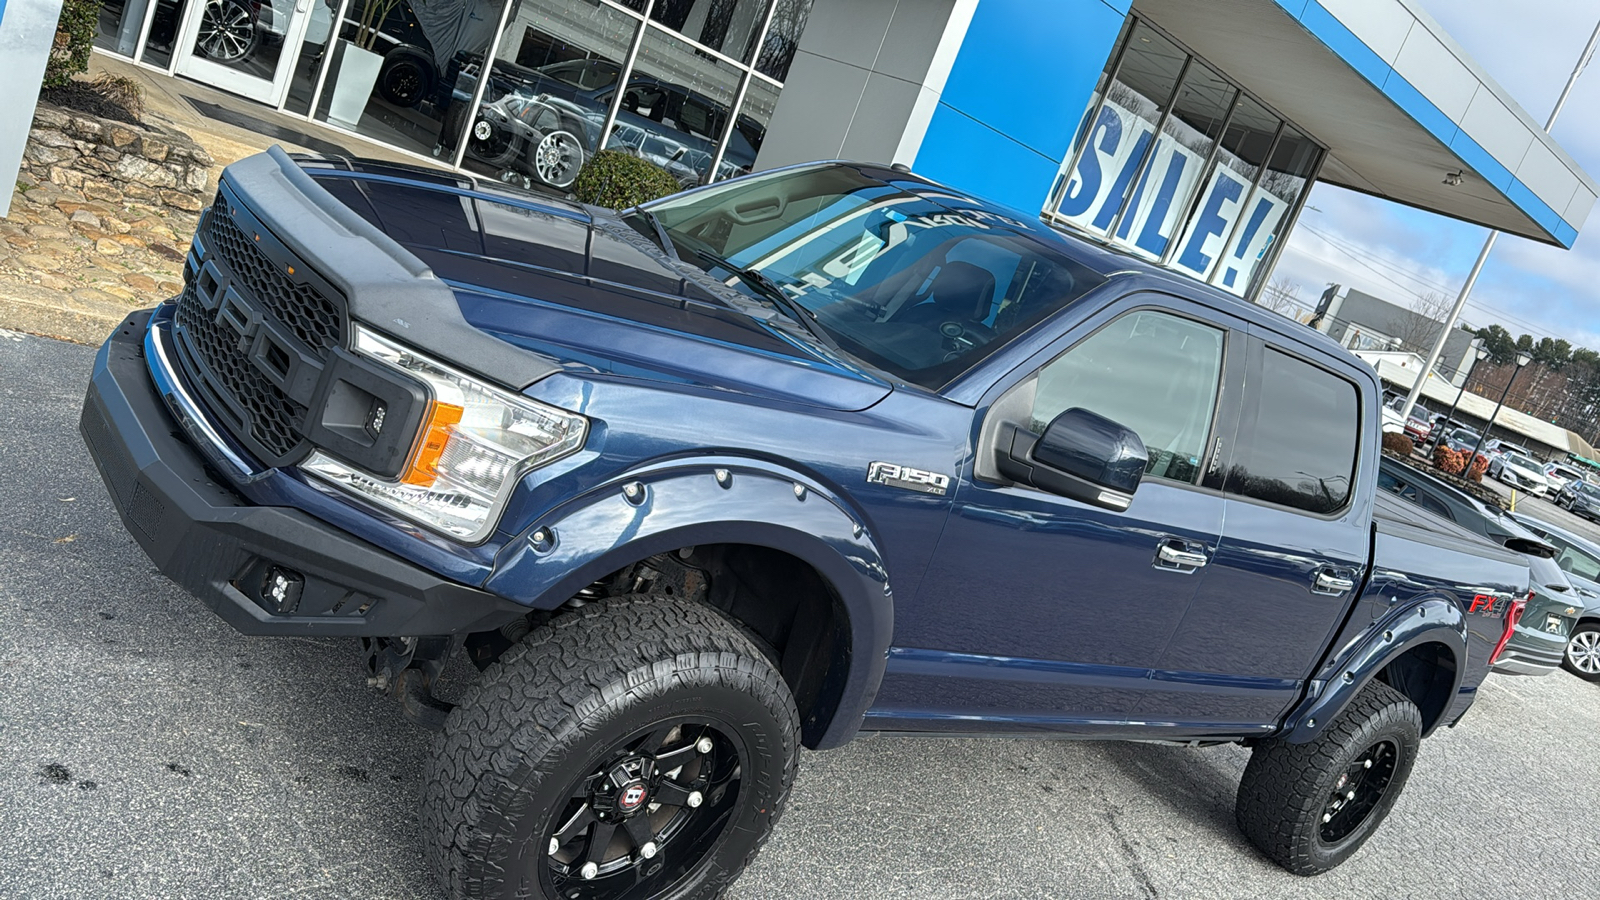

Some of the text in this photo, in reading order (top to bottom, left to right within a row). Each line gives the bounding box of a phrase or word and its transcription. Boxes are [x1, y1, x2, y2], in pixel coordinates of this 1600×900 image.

[1051, 104, 1274, 288] SALE!
[926, 486, 944, 494] XLT
[1467, 593, 1507, 613] FX4
